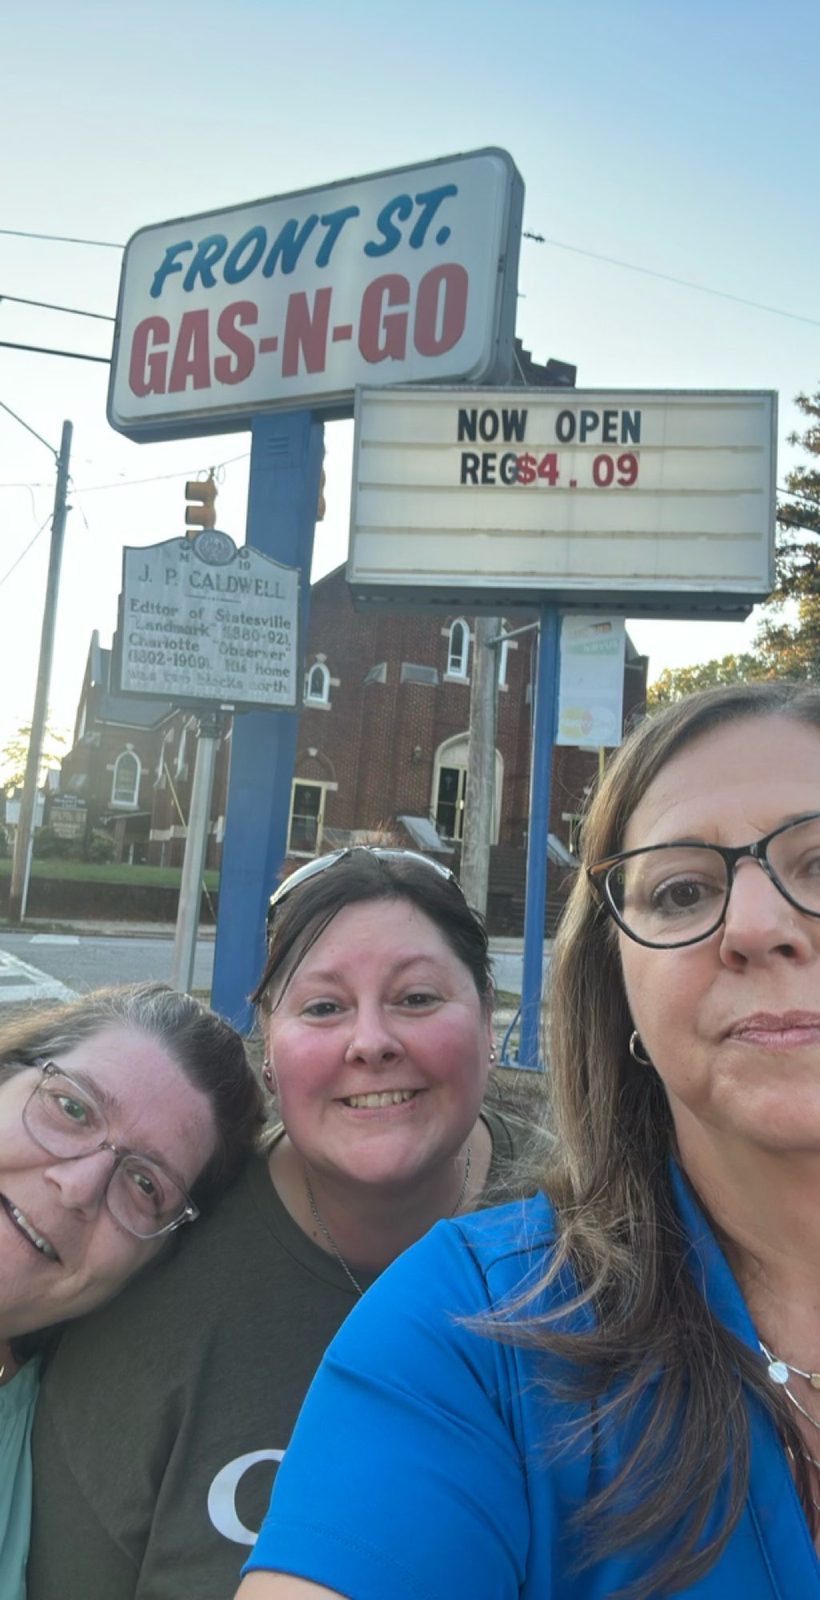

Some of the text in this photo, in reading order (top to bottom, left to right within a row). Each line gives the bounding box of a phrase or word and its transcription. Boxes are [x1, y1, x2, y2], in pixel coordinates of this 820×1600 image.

[150, 184, 459, 298] FRONT ST.
[128, 263, 469, 398] GAS-N-GO
[457, 409, 642, 443] NOW OPEN
[460, 452, 517, 485] REG
[138, 564, 286, 599] J. P. CALDWELL
[130, 598, 291, 630] Editor of Statesville
[255, 662, 290, 678] home
